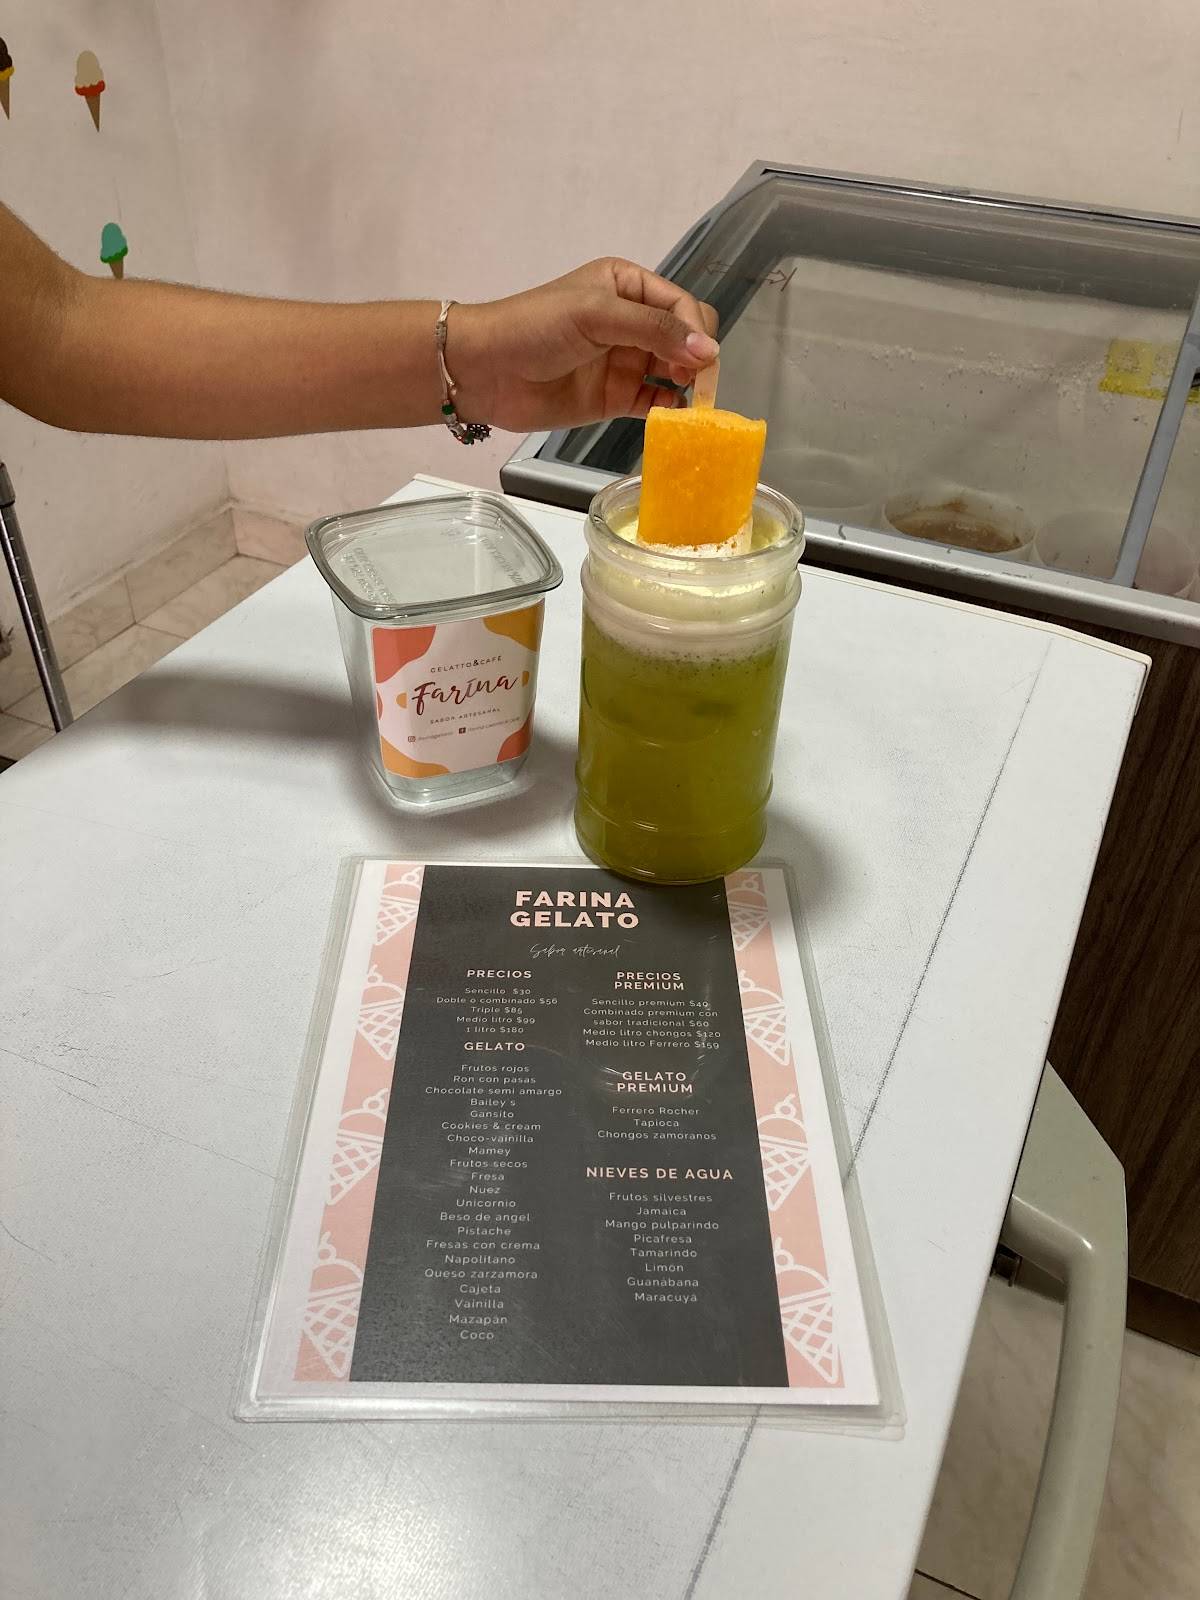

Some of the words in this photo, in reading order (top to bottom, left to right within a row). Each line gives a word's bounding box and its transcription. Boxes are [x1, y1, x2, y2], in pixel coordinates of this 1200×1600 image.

[515, 891, 635, 908] FARINA
[510, 911, 640, 929] GELATO
[467, 970, 532, 979] PRECIOS
[617, 972, 681, 981] PRECIOS
[614, 981, 684, 991] PREMIUM
[591, 998, 635, 1006] Sencillo
[639, 1000, 685, 1008] premium
[583, 1008, 644, 1016] Combinado
[648, 1010, 695, 1018] premium
[627, 1019, 685, 1027] tradicional
[620, 1029, 643, 1037] litro
[646, 1030, 692, 1038] chongos
[695, 1030, 721, 1038] $120
[464, 1042, 525, 1051] GELATO
[585, 1039, 619, 1047] Medio
[623, 1039, 646, 1047] litro
[650, 1040, 690, 1048] Ferrero
[461, 1064, 497, 1072] Frutos
[502, 1064, 530, 1073] rojos
[453, 1075, 475, 1083] Ron
[503, 1077, 536, 1085] pasas
[622, 1072, 687, 1082] GELATO
[425, 1086, 484, 1095] Chocolate
[488, 1087, 515, 1095] semi
[519, 1089, 562, 1097] amargo
[617, 1083, 693, 1093] PREMIUM
[470, 1110, 514, 1118] Gansito
[612, 1106, 655, 1115] Ferrero
[659, 1107, 700, 1115] Rocher
[441, 1122, 488, 1130] Cookies
[492, 1122, 500, 1130] &
[504, 1123, 541, 1131] cream
[634, 1119, 680, 1128] Tapioca
[447, 1134, 534, 1143] Choco-vainilla
[597, 1130, 649, 1141] Chongos
[653, 1132, 717, 1140] zamoranos
[468, 1147, 511, 1156] Mamey
[450, 1159, 489, 1168] Frutos
[471, 1172, 505, 1181] Fresa
[586, 1167, 649, 1179] NIEVES
[656, 1168, 678, 1179] DE
[685, 1168, 733, 1180] AGUA
[469, 1185, 501, 1194] Nuez
[609, 1192, 649, 1201] Frutos
[653, 1193, 713, 1202] silvestres
[456, 1199, 516, 1208] Unicornio
[636, 1207, 687, 1216] Jamaica
[440, 1212, 471, 1221] Beso
[475, 1213, 491, 1221] de
[495, 1213, 530, 1224] angel
[605, 1219, 647, 1230] Mango
[651, 1221, 719, 1230] pulparindo
[457, 1226, 511, 1236] Pistache
[634, 1234, 692, 1244] Picafresa
[426, 1240, 469, 1249] Fresas
[501, 1242, 540, 1250] crema
[630, 1248, 697, 1258] Tamarindo
[445, 1254, 516, 1265] Napolitano
[424, 1268, 466, 1278] Queso
[470, 1270, 538, 1279] zarzamora
[459, 1284, 501, 1295] Cajeta
[454, 1299, 504, 1309] Vainilla
[459, 1329, 494, 1340] Coco
